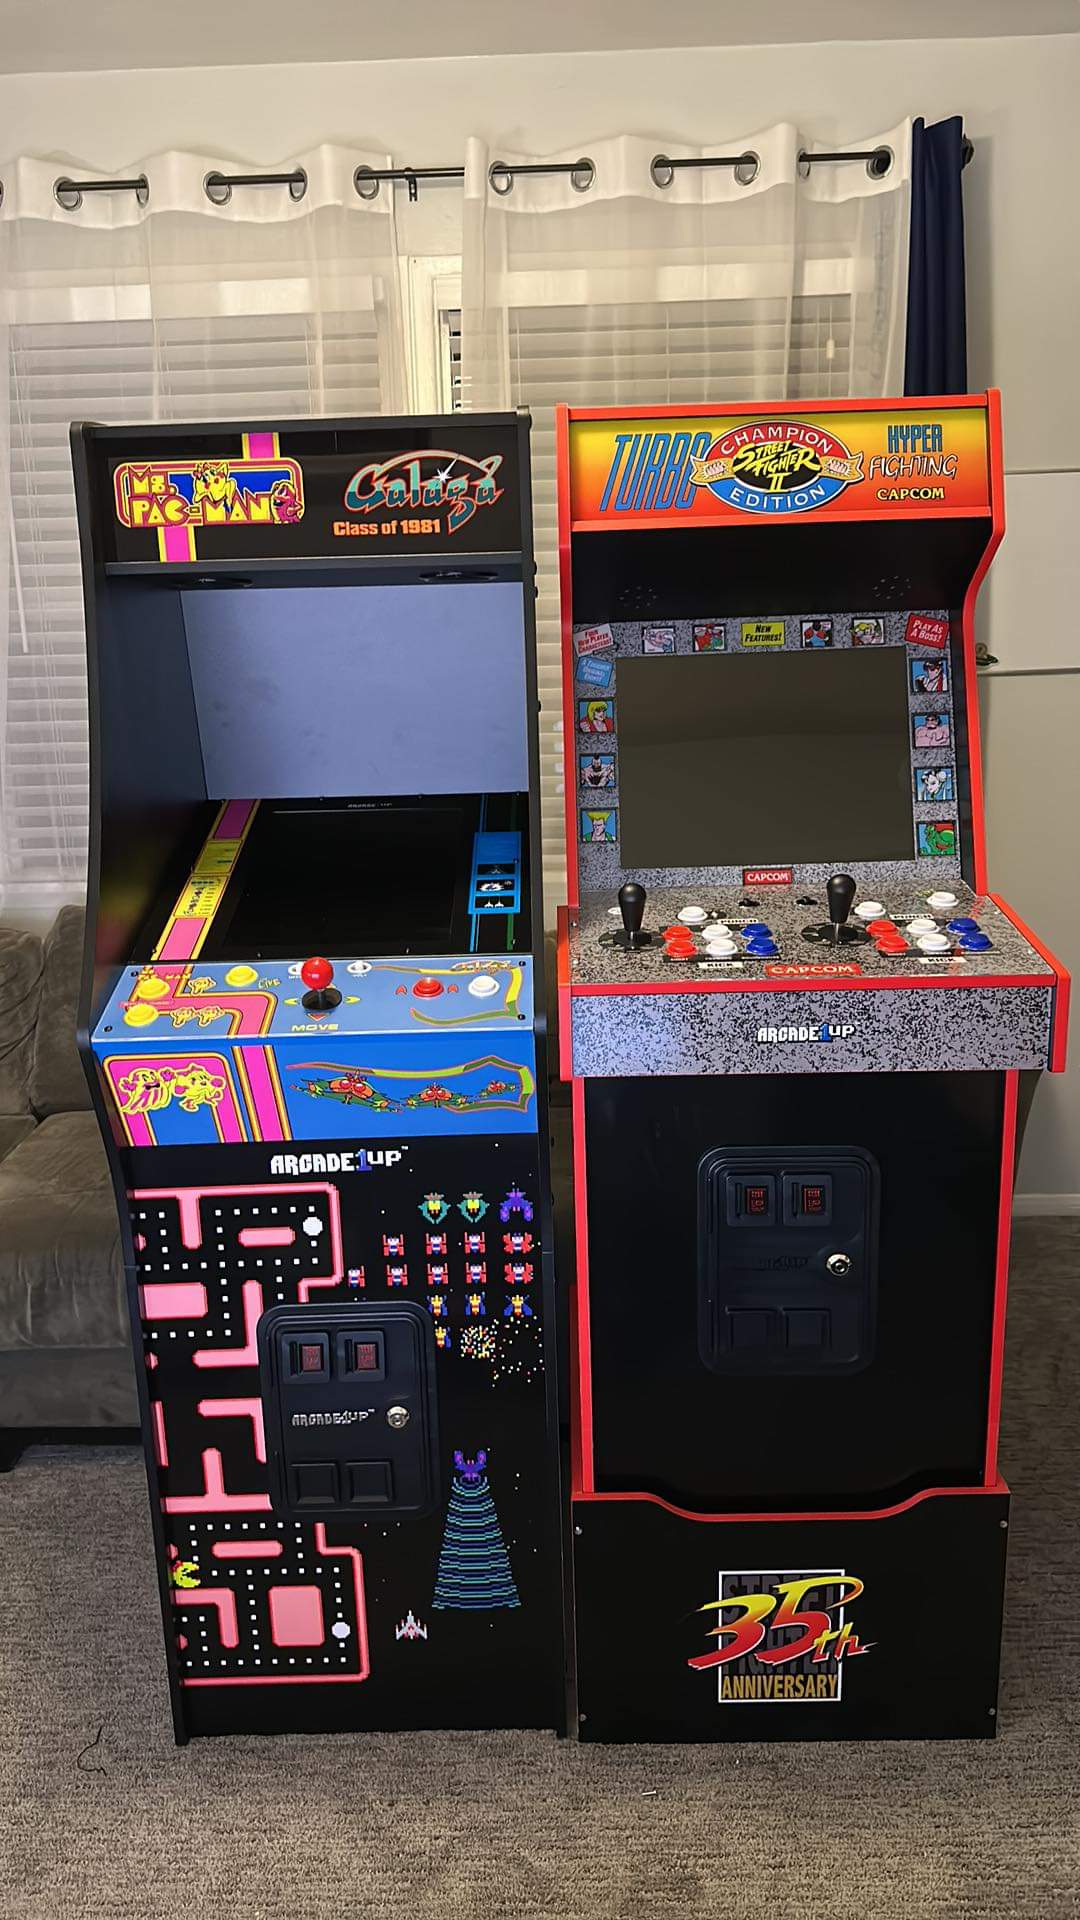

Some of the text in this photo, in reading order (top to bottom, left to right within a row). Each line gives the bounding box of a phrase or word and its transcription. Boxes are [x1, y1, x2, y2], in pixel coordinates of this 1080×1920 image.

[720, 424, 833, 455] CHAMPION
[887, 424, 943, 453] HYPER
[733, 440, 792, 472] STREET
[749, 447, 822, 477] FIGHTER
[869, 454, 958, 481] FIGHTING
[600, 431, 712, 512] TURBO
[766, 473, 792, 493] II
[730, 485, 826, 510] EDITION
[877, 487, 945, 501] CAPCOM
[128, 491, 273, 527] PAC-MAN
[333, 518, 441, 537] Class of 1981
[747, 872, 789, 882] CAPCOM
[770, 965, 855, 975] CAPCOM
[291, 1022, 340, 1033] MOVE
[687, 1575, 878, 1671] 35th
[721, 1674, 838, 1699] ANNIVERSARY
